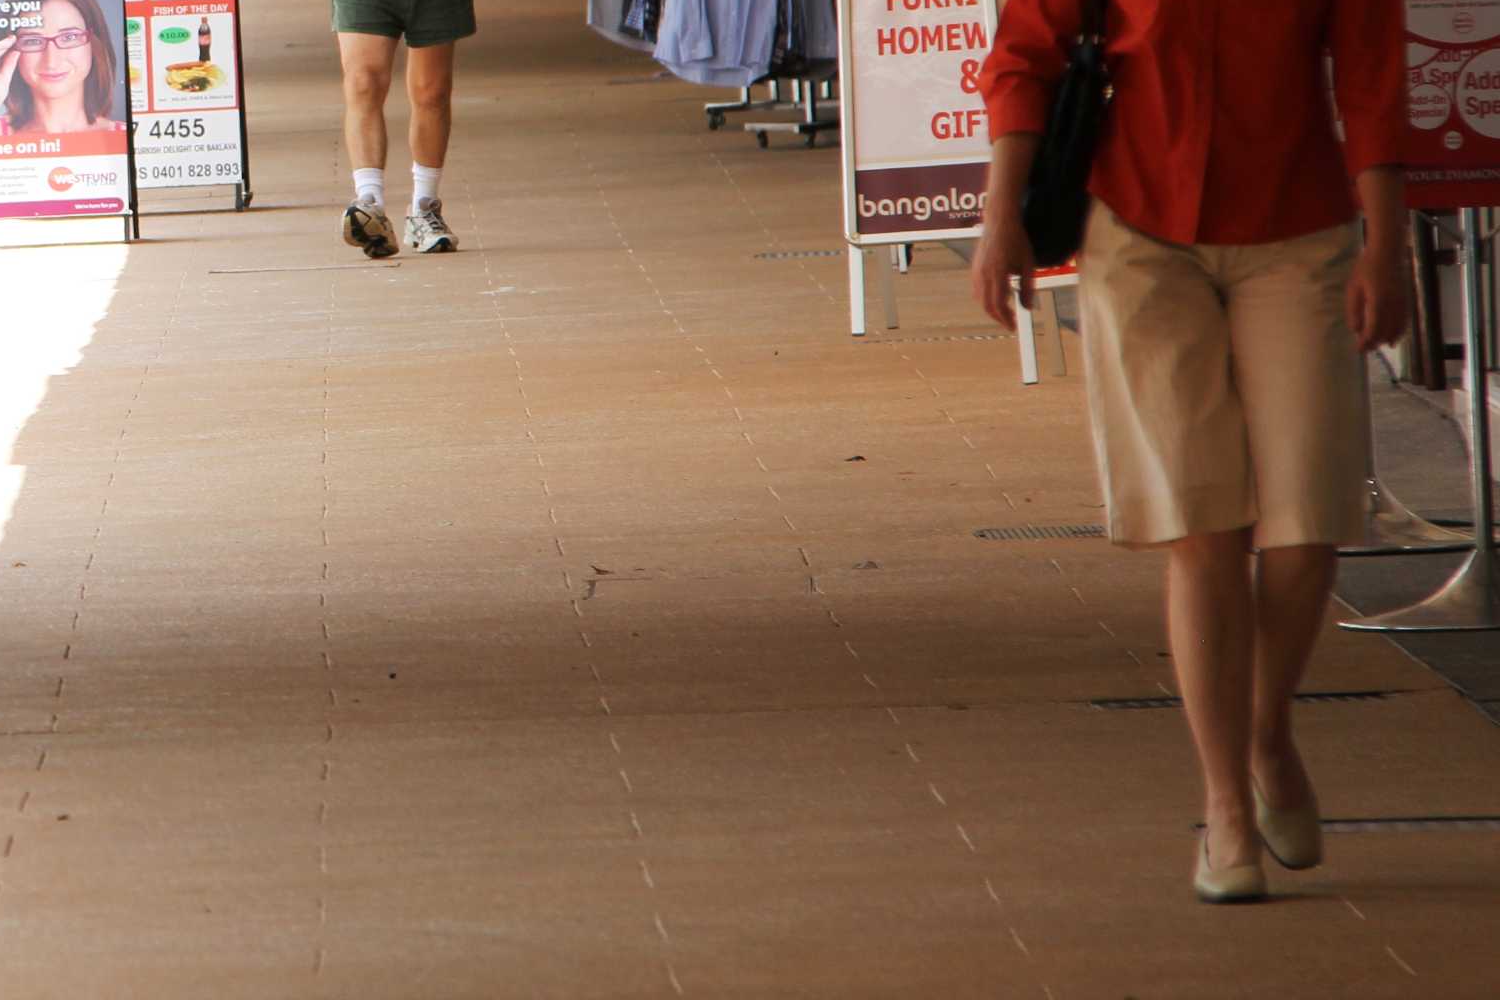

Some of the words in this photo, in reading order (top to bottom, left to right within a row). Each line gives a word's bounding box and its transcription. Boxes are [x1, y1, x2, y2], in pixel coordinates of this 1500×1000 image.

[11, 0, 41, 16] you
[153, 6, 174, 16] FISH
[176, 5, 188, 15] OF
[190, 4, 208, 14] THE
[210, 3, 228, 13] DAY
[10, 15, 44, 31] past
[959, 58, 981, 95] &
[149, 117, 206, 139] 4455
[16, 142, 37, 154] on
[40, 138, 61, 153] in!
[152, 165, 183, 179] 0401
[188, 164, 212, 178] 828
[215, 162, 240, 177] 993
